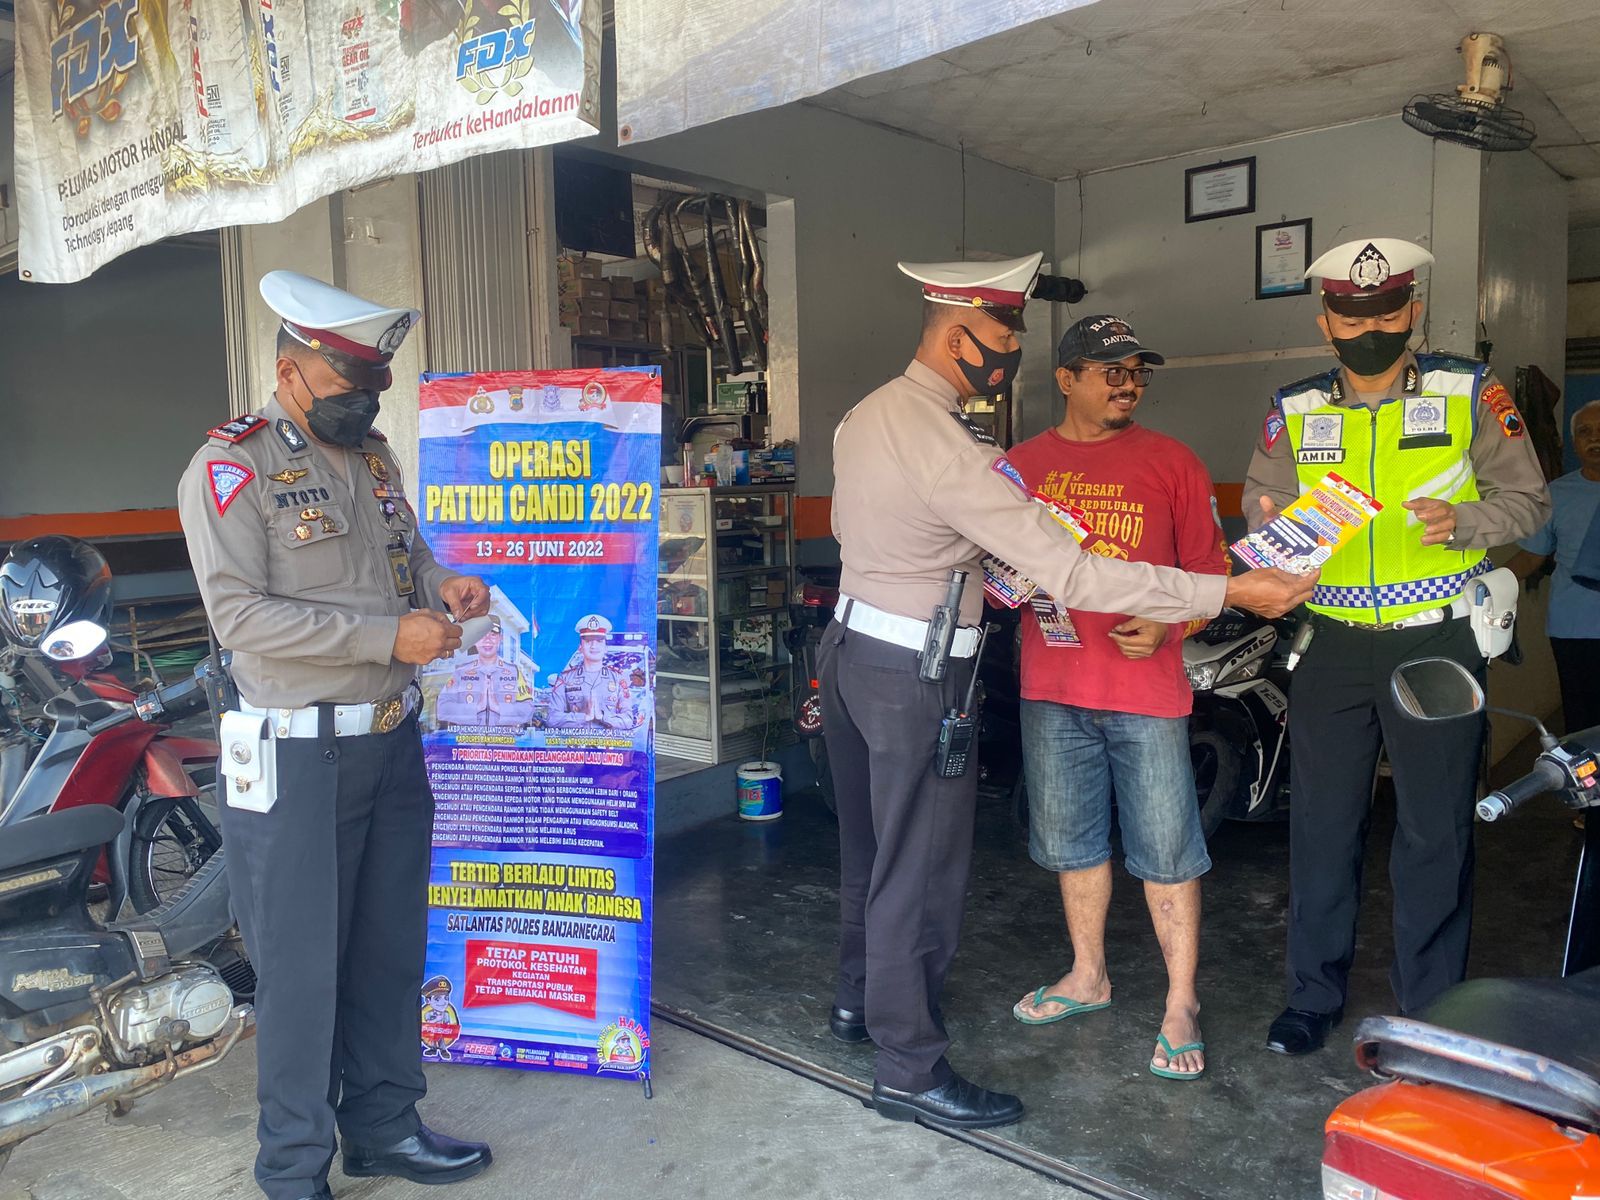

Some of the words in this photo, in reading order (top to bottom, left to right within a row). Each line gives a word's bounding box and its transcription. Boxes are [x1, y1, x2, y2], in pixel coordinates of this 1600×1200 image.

[456, 18, 536, 79] FDX
[412, 117, 463, 150] Terbukti
[99, 144, 140, 180] MOTOR
[140, 118, 187, 160] HANDAL
[101, 189, 130, 213] dengan
[489, 440, 591, 479] OPERASI
[1301, 452, 1336, 461] AMIN
[274, 487, 330, 509] NYOTO
[426, 485, 504, 522] PATUH
[510, 484, 584, 522] CANDI
[590, 482, 653, 521] 2022
[1080, 500, 1144, 513] SEDULURAN
[476, 542, 491, 557] 13
[506, 542, 524, 556] 26
[528, 541, 564, 561] JUNI
[568, 541, 604, 557] 2022
[15, 602, 50, 610] INK
[1260, 688, 1284, 708] 125
[452, 749, 458, 760] 7
[458, 749, 493, 760] PRIORITAS
[493, 750, 534, 762] PENINDAKAN
[535, 751, 585, 763] PELANGGARAN
[451, 862, 500, 882] TERTIB
[503, 864, 565, 885] BERLALU
[568, 867, 615, 890] LINTAS
[545, 891, 584, 913] ANAK
[586, 894, 642, 919] BANGSA
[447, 914, 503, 932] SATLANTAS
[505, 917, 540, 935] POLRES
[542, 919, 616, 942] BANJARNEGARA
[486, 946, 526, 960] TETAP
[531, 951, 579, 964] PATUHI
[477, 958, 527, 970] PROTOKOL
[530, 962, 587, 975] KESEHATAN
[512, 971, 550, 980] KEGIATAN
[475, 985, 503, 994] TETAP
[505, 987, 546, 998] MEMAKAI
[549, 992, 586, 1002] MASKER
[487, 978, 544, 989] TRANSPORTASI
[546, 984, 573, 992] PUBLIK
[619, 1016, 651, 1048] HADIR
